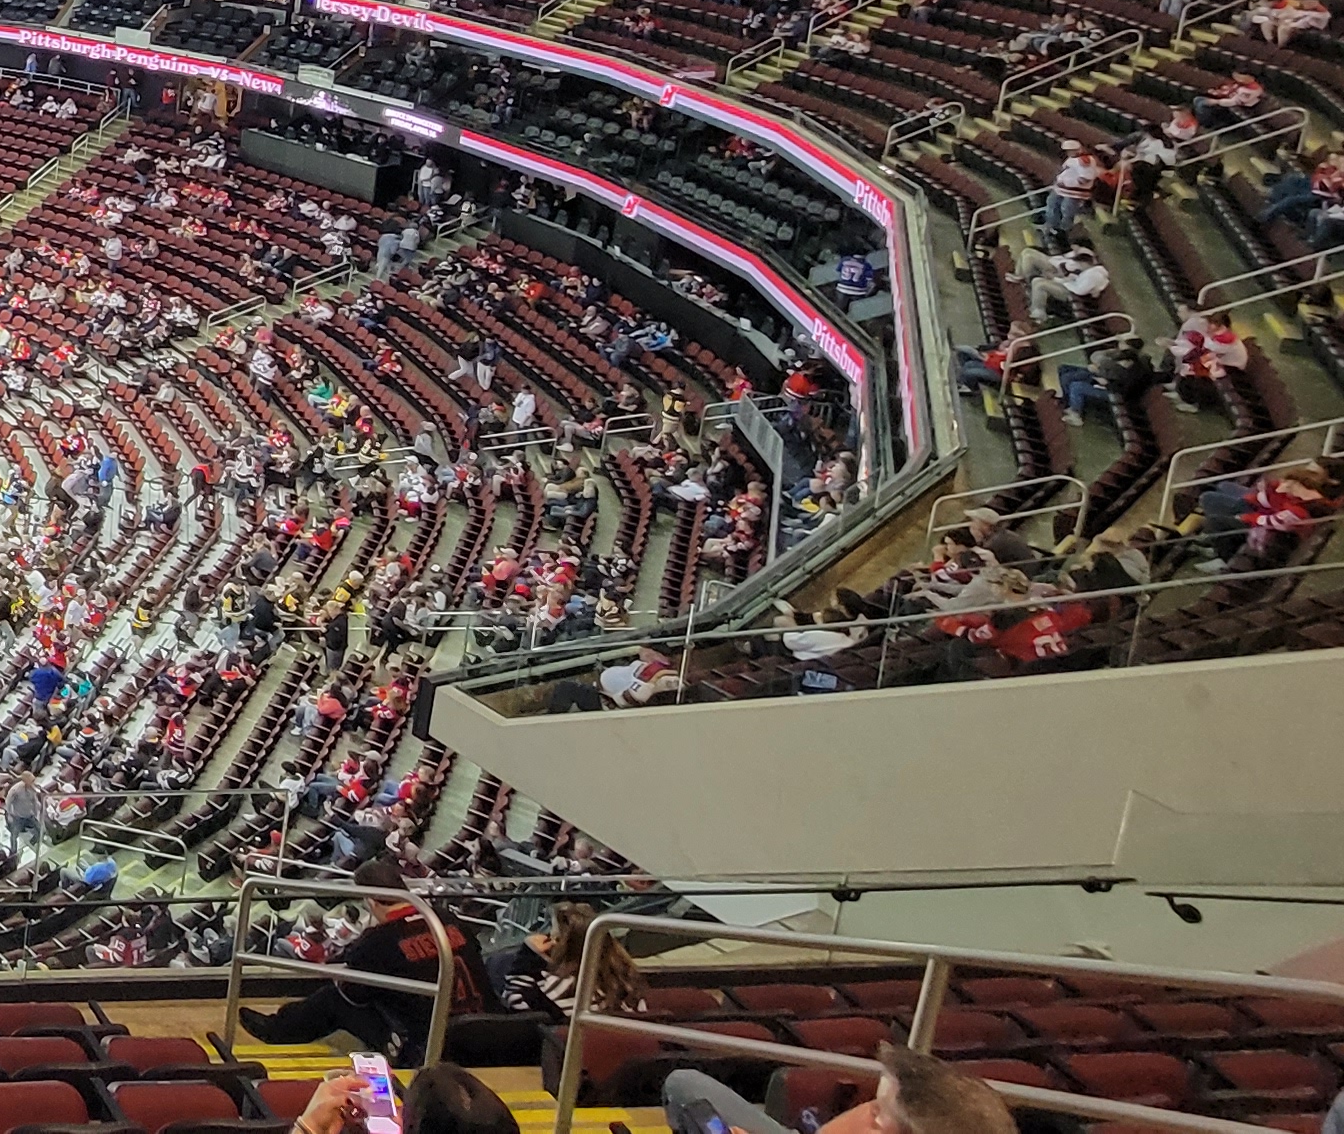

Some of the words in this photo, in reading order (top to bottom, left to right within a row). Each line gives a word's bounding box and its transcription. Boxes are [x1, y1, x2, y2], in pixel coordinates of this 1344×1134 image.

[374, 6, 435, 32] Devils
[18, 30, 112, 60] Pittsburgh
[115, 48, 199, 77] Penguins
[238, 72, 272, 92] New
